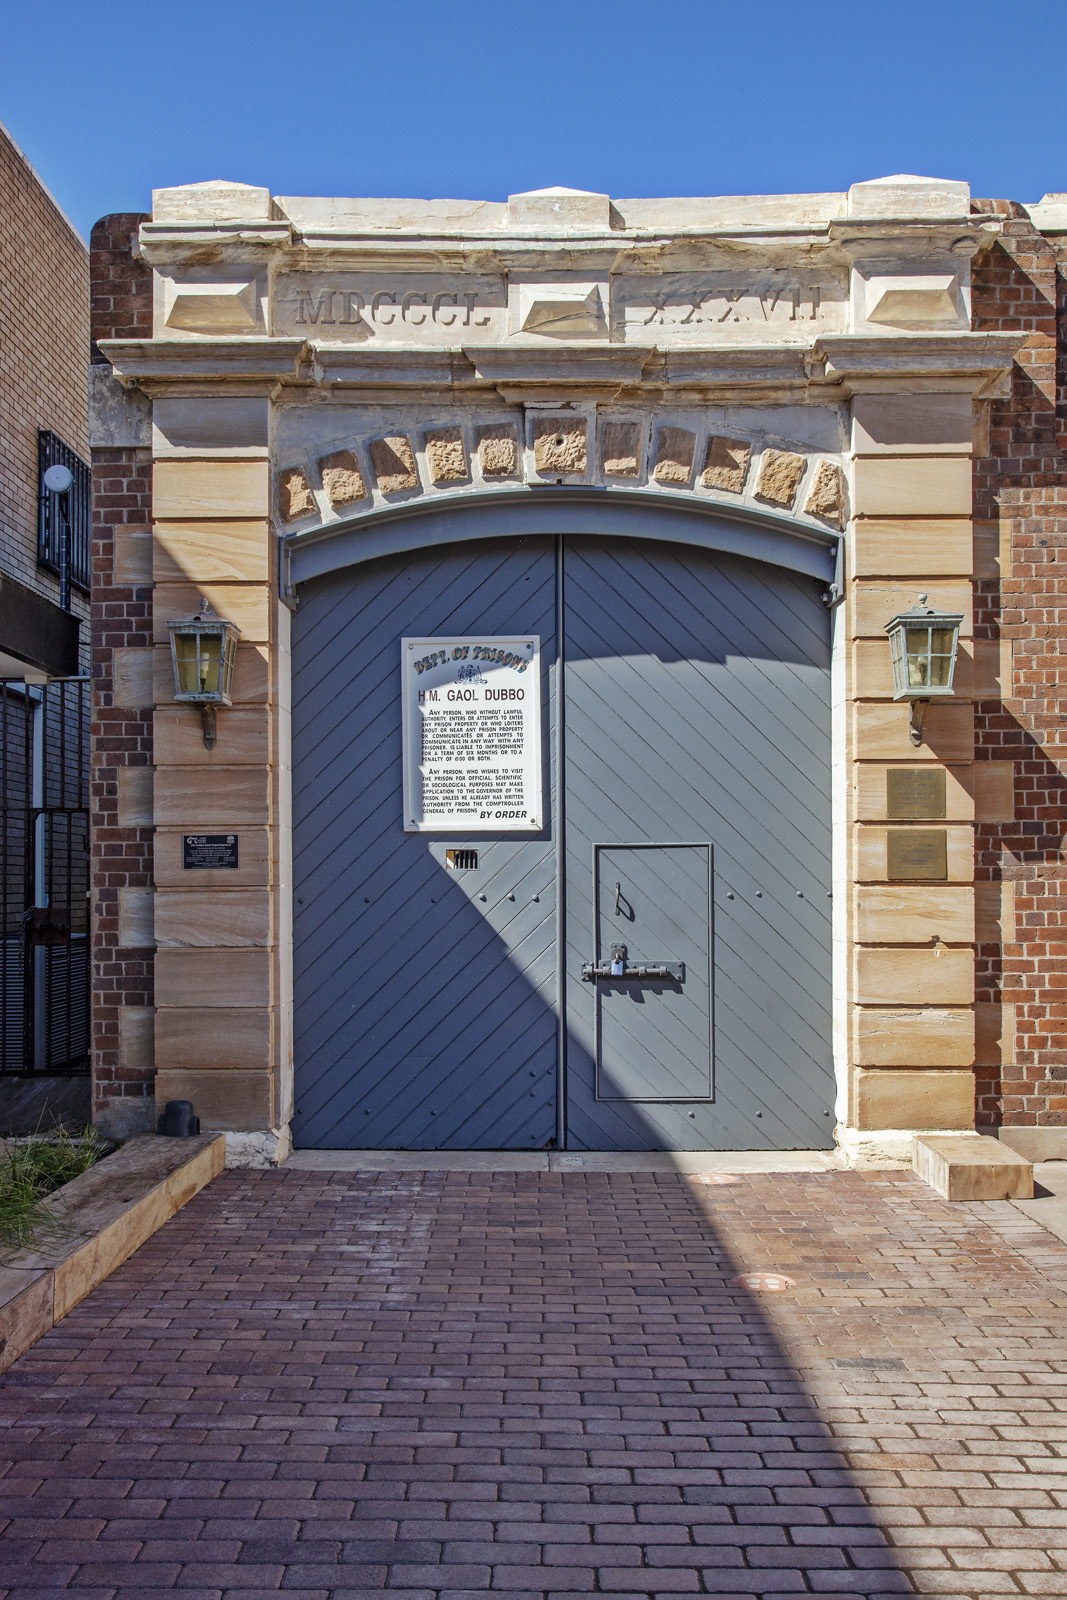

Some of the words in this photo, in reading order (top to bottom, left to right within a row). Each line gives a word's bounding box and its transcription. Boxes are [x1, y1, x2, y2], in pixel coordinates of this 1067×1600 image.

[295, 288, 491, 326] MDCCCL
[451, 646, 470, 661] OF
[472, 646, 530, 673] PRISONS
[418, 690, 441, 702] H.M.
[447, 689, 479, 702] GAOL
[485, 688, 525, 701] DUBBO
[495, 810, 528, 818] ORDER
